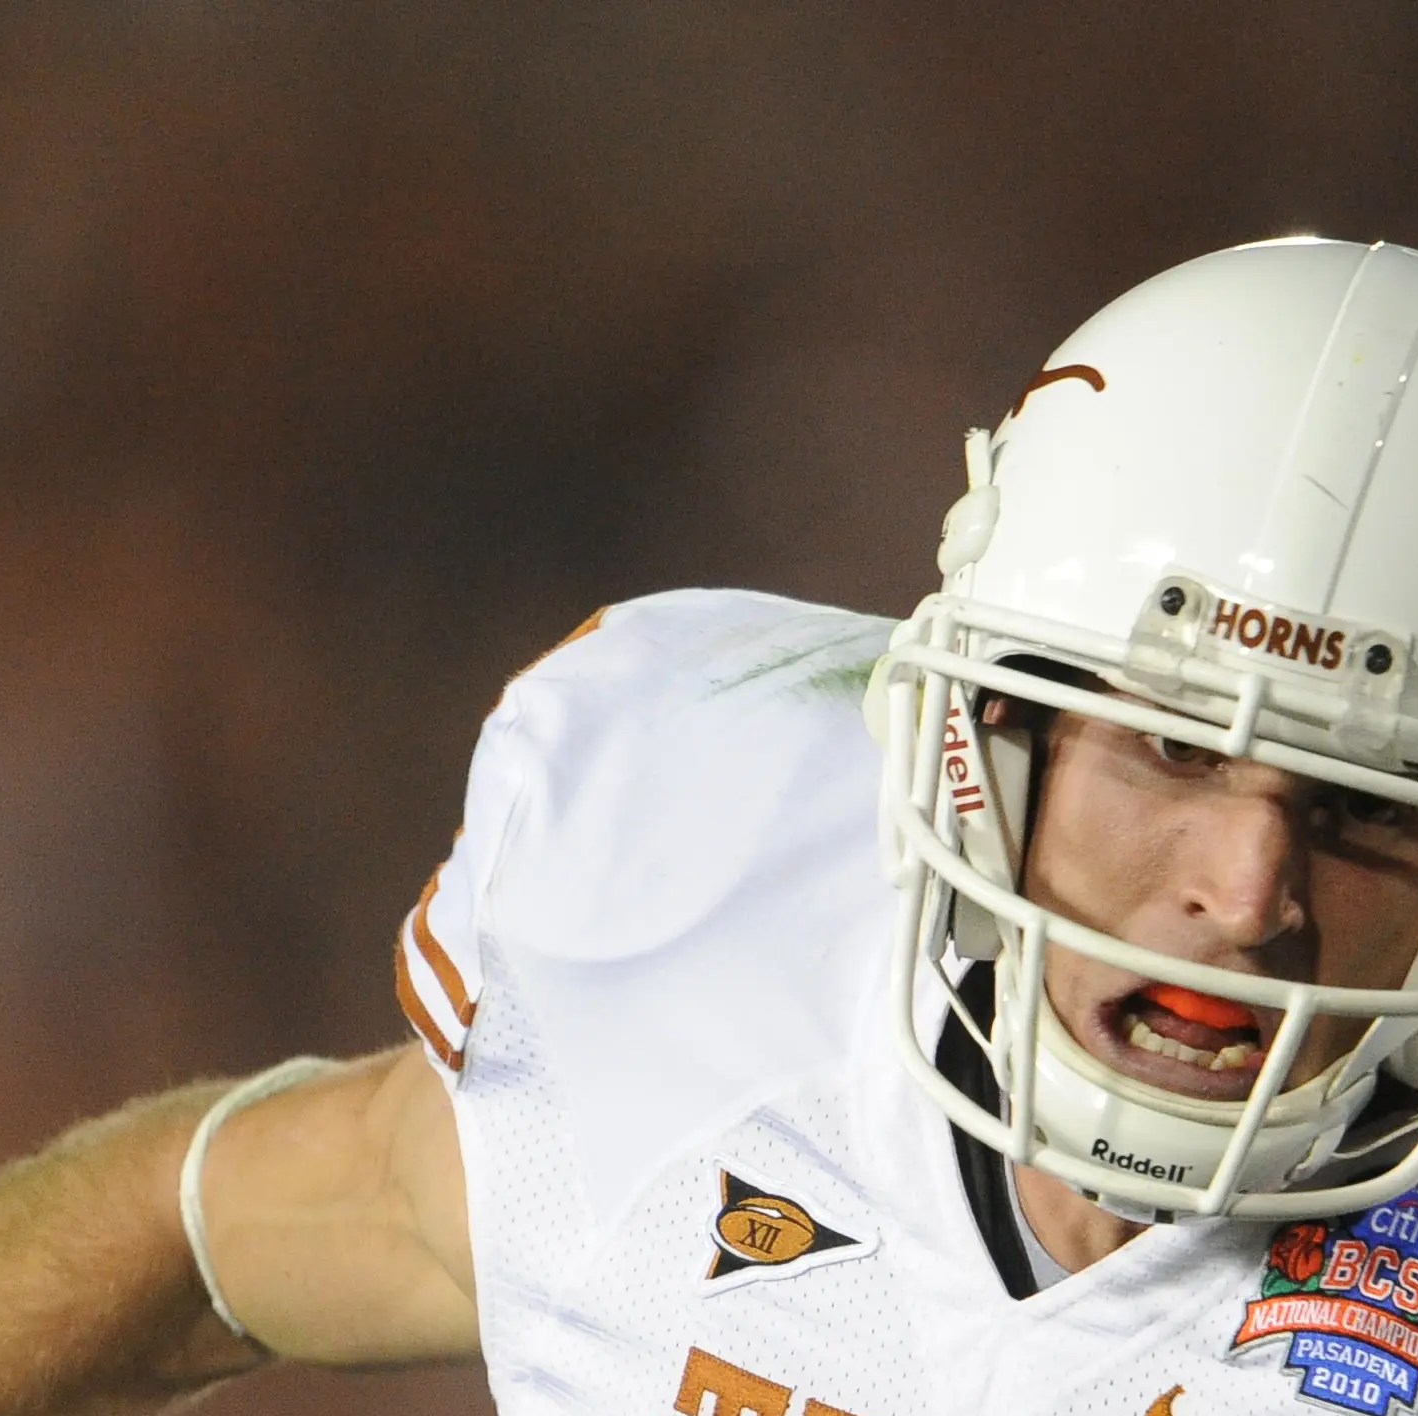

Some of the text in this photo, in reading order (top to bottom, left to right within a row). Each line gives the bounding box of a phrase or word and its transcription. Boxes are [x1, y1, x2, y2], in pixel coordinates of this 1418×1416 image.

[1209, 599, 1346, 671] HORNS
[943, 707, 985, 814] dell
[1091, 1138, 1186, 1183] Riddell
[739, 1218, 781, 1254] XII
[1249, 1300, 1340, 1333] NATIONAL
[1297, 1338, 1410, 1391] PASADENA
[1311, 1367, 1382, 1405] 2010
